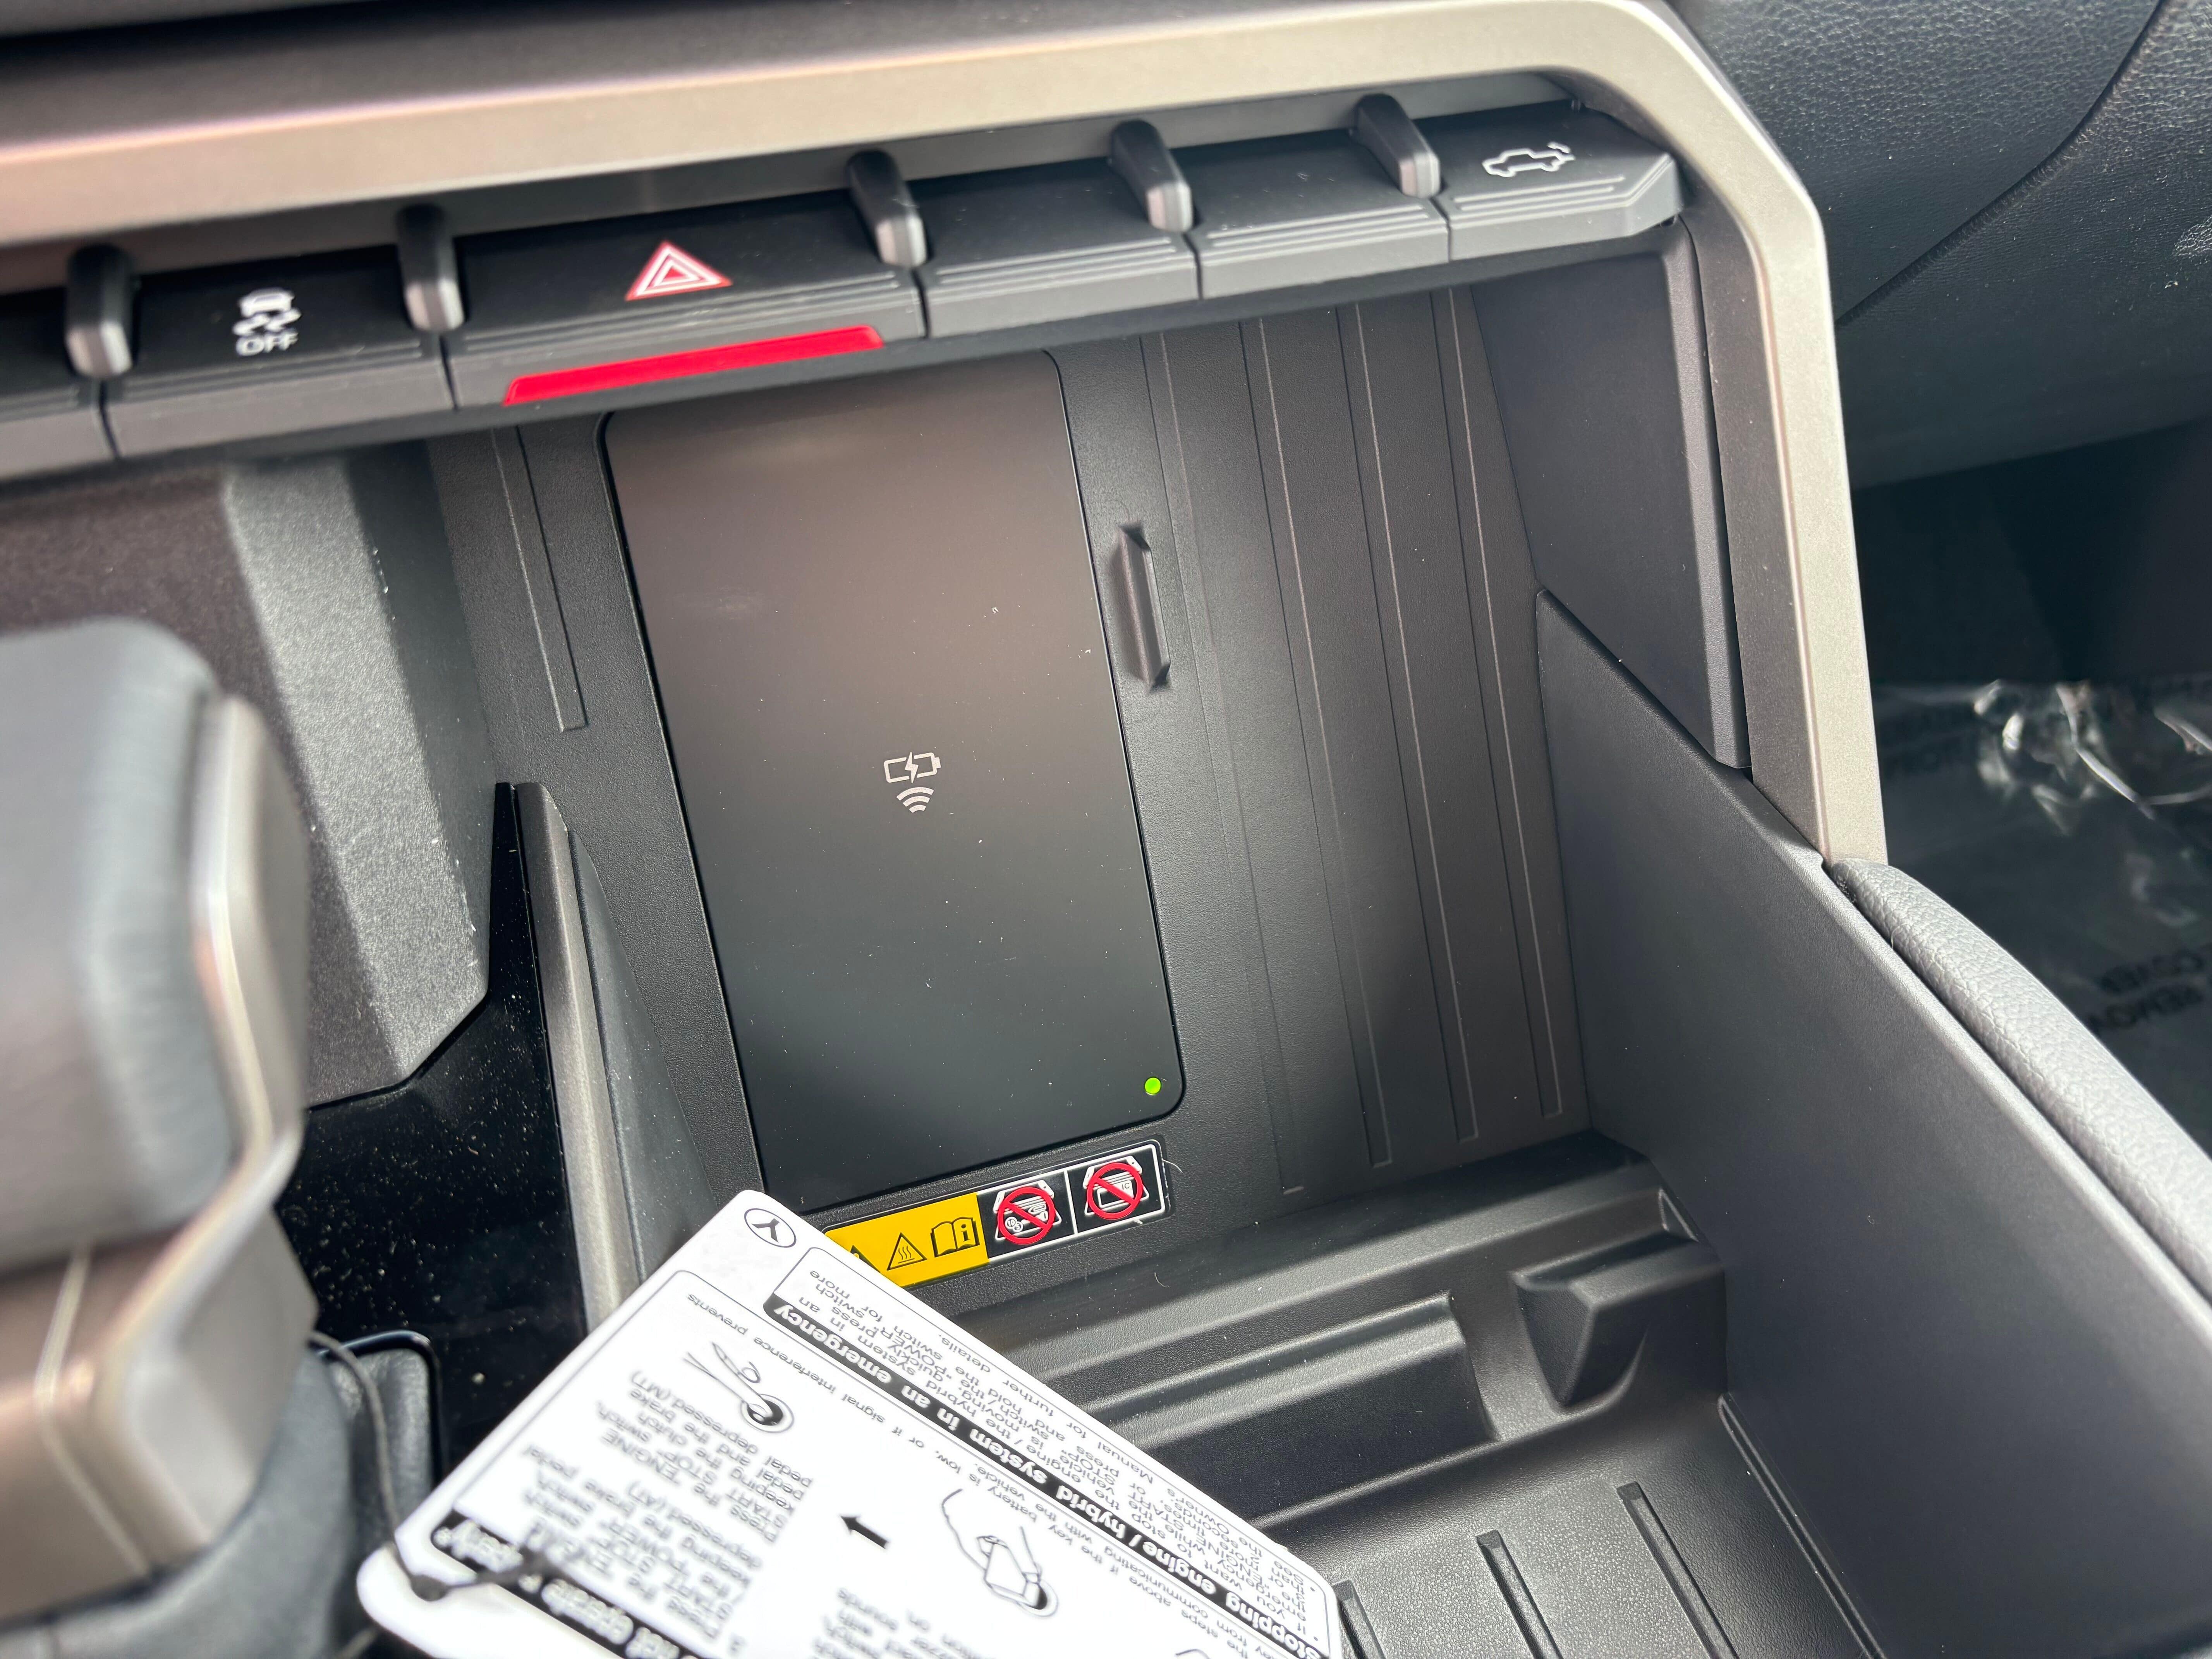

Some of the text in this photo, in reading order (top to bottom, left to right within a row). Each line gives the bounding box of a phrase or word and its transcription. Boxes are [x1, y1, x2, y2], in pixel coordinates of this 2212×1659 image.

[236, 330, 298, 356] OFF
[1122, 1182, 1131, 1190] IC
[810, 1270, 850, 1299] more
[687, 1294, 749, 1335] prevents
[799, 1297, 820, 1313] an
[816, 1284, 865, 1318] switch
[859, 1306, 883, 1322] for
[830, 1317, 845, 1331] in
[831, 1307, 878, 1338] press
[774, 1305, 892, 1383] emergency
[857, 1335, 916, 1376] system
[891, 1326, 943, 1360] switch
[753, 1337, 836, 1394] interference
[887, 1341, 945, 1382] quickly
[955, 1366, 979, 1386] the
[960, 1379, 985, 1399] the
[841, 1394, 885, 1423] signal
[901, 1385, 931, 1408] an
[925, 1380, 977, 1417] hybrid
[988, 1388, 1022, 1415] hold
[892, 1427, 902, 1436] if
[937, 1408, 960, 1431] in
[986, 1419, 1011, 1439] the
[1000, 1405, 1049, 1440] switch
[1035, 1419, 1065, 1441] and
[908, 1437, 924, 1448] or
[1031, 1436, 1044, 1450] is
[938, 1334, 1304, 1586] See the Owner's Manual for further details.
[969, 1429, 1048, 1484] system
[1026, 1445, 1084, 1483] engine
[1076, 1446, 1119, 1478] press
[969, 1474, 981, 1486] is
[1056, 1455, 1115, 1495] vehicle
[1095, 1489, 1120, 1510] the
[1129, 1483, 1146, 1495] or
[987, 1486, 1037, 1523] battery
[1035, 1503, 1057, 1522] the
[1056, 1485, 1126, 1539] hybrid
[1128, 1500, 1153, 1522] the
[1128, 1492, 1184, 1531] START
[1048, 1525, 1073, 1546] key
[1065, 1522, 1092, 1544] with
[1131, 1513, 1166, 1539] stop
[1164, 1524, 1206, 1555] while
[1081, 1546, 1102, 1564] the
[1165, 1499, 1305, 1595] than 2 seconds.
[1177, 1544, 1192, 1558] to
[1219, 1541, 1259, 1571] more
[1109, 1565, 1119, 1575] if
[1142, 1541, 1216, 1594] engine
[1204, 1559, 1242, 1590] want
[1104, 1546, 1209, 1619] communicating
[1129, 1576, 1171, 1606] above
[1217, 1559, 1306, 1621] emergency
[1268, 1575, 1284, 1588] or
[1257, 1595, 1285, 1619] you
[1281, 1591, 1306, 1613] the
[1295, 1592, 1305, 1604] 3
[1181, 1609, 1218, 1638] steps
[1216, 1620, 1247, 1647] from
[1297, 1622, 1306, 1635] If
